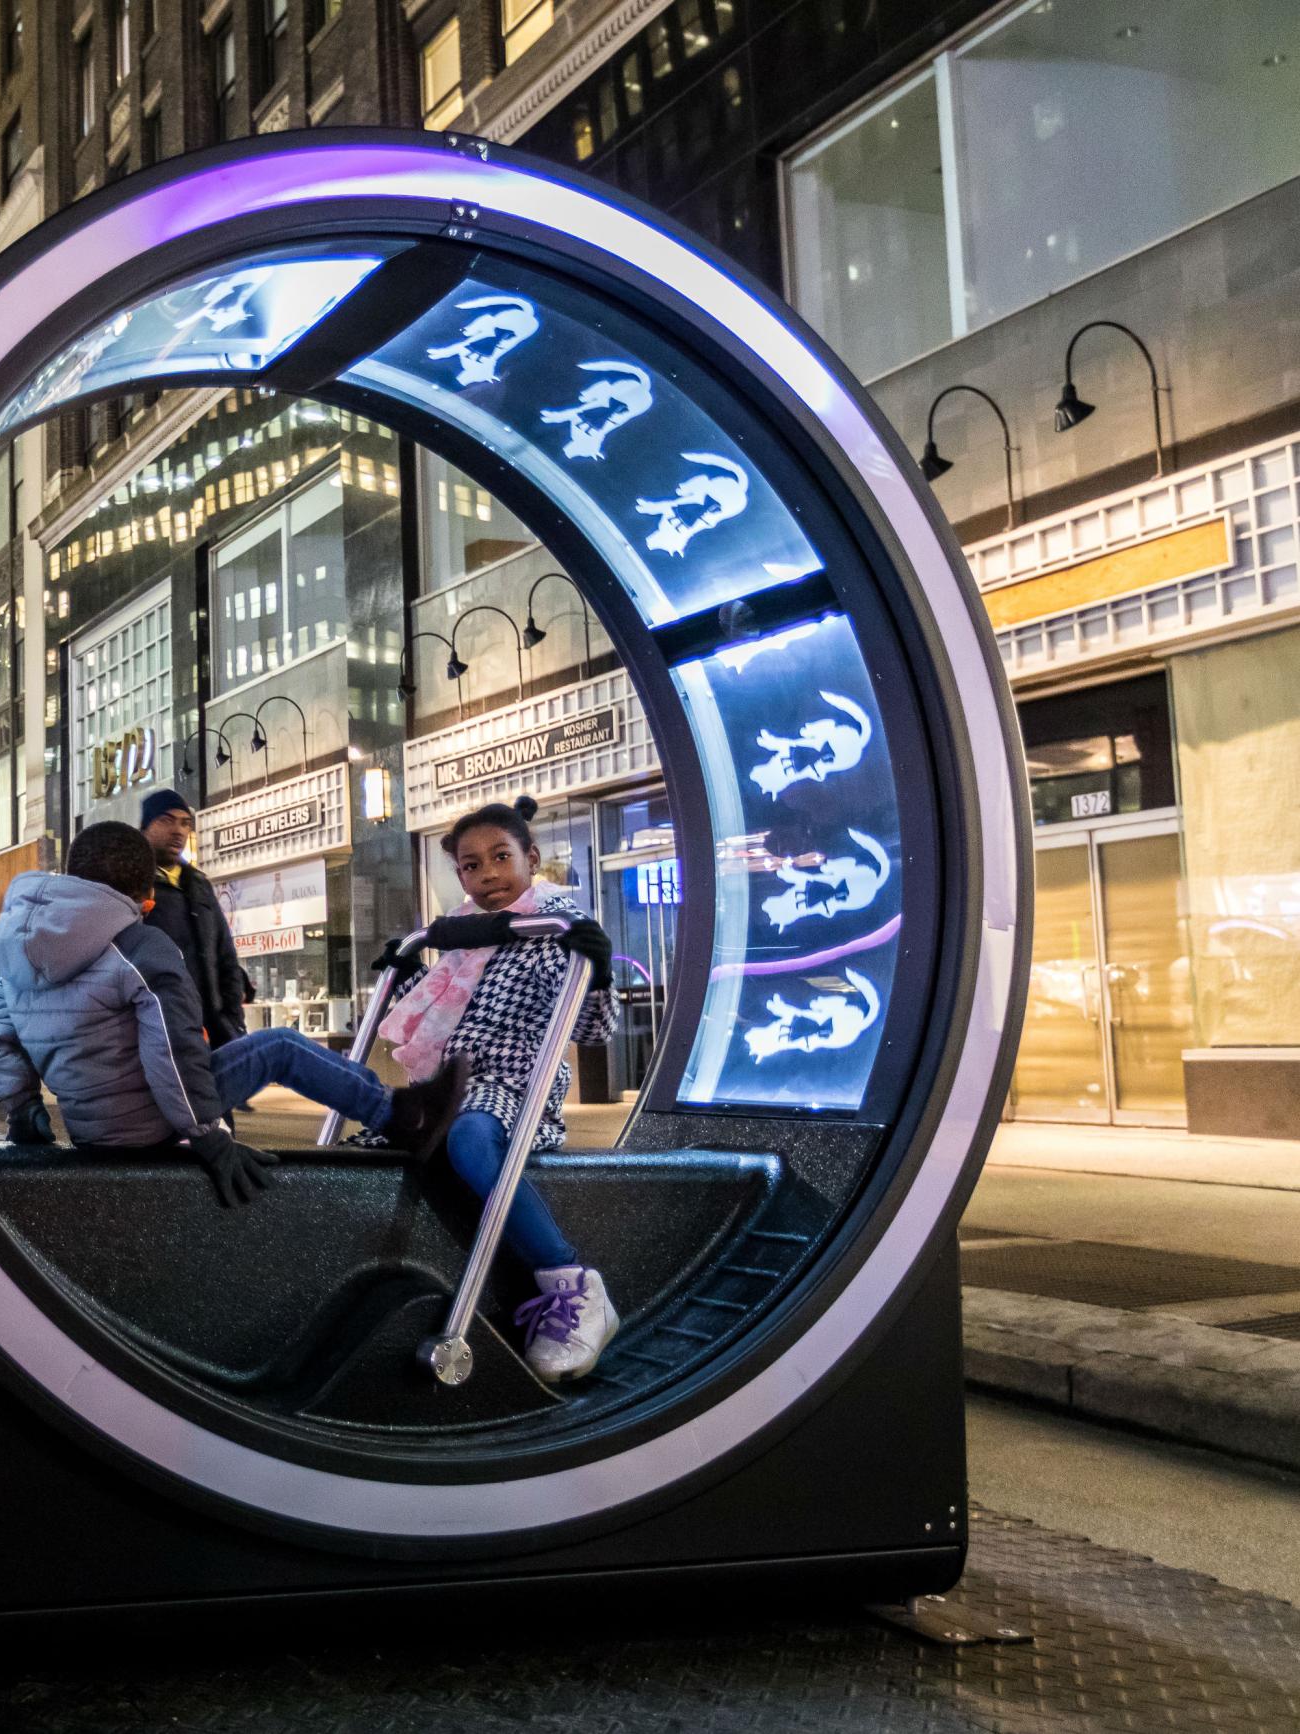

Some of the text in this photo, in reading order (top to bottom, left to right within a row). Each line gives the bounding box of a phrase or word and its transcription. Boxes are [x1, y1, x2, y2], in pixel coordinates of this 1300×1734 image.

[553, 727, 611, 754] RESTAURANT
[563, 716, 599, 739] KOSHER
[436, 733, 550, 787] MR. BROADWAY
[1074, 791, 1108, 816] 1372
[218, 805, 311, 848] ALLEN M JEWELERS
[235, 935, 257, 948] SALE
